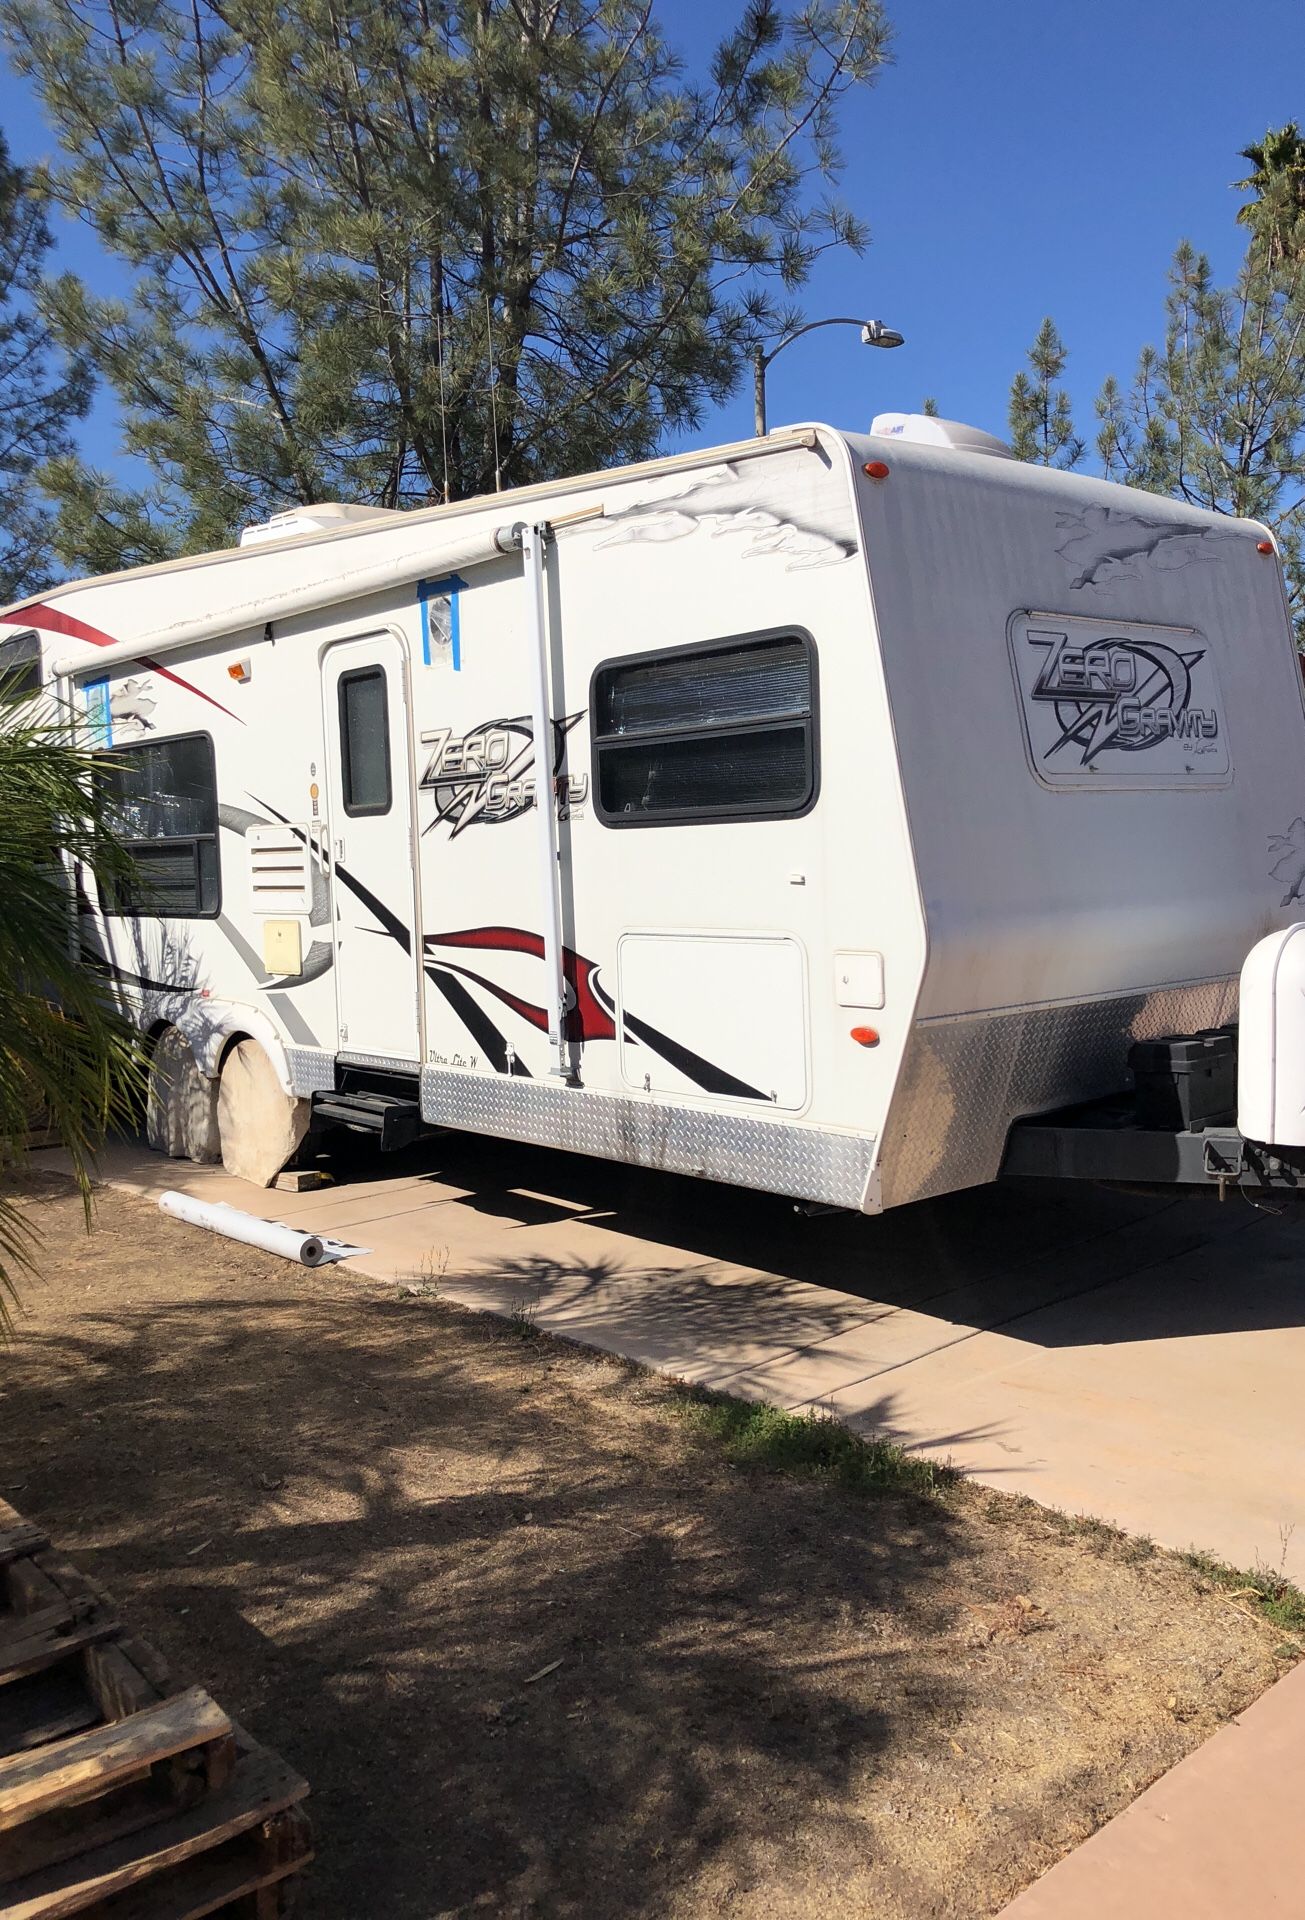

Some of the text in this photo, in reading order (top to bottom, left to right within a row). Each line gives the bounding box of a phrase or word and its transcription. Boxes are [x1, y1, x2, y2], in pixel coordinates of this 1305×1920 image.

[1027, 630, 1136, 703] ZERO
[1117, 697, 1218, 739] GRAVITY
[419, 728, 510, 790] ZERO
[485, 772, 589, 810] GRATY
[429, 1050, 448, 1064] Ultra
